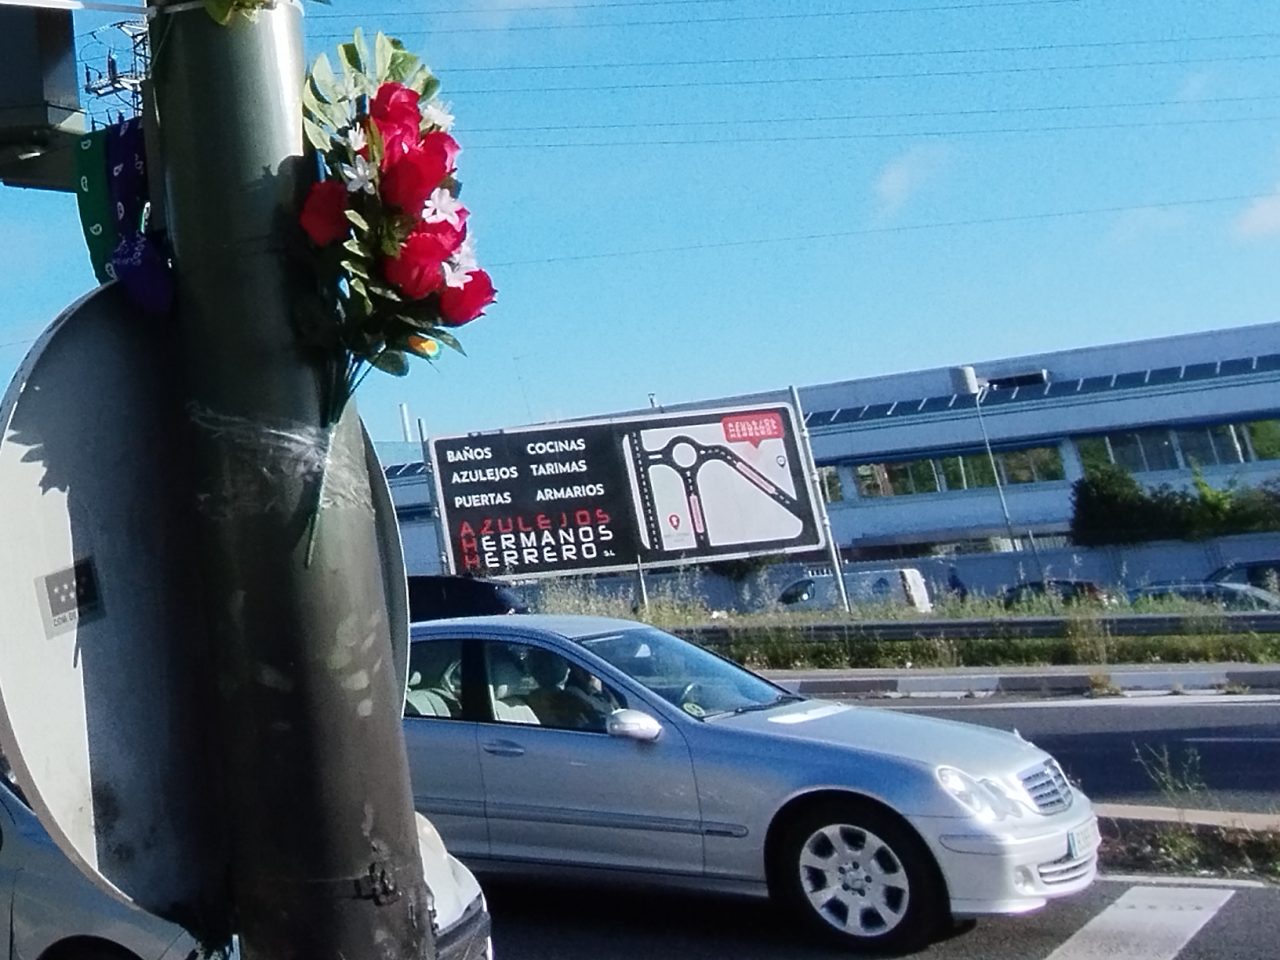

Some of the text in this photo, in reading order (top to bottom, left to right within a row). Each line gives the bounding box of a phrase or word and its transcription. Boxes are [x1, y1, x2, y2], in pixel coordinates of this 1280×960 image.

[446, 446, 493, 462] BAÑOS
[526, 438, 586, 455] COCINAS
[451, 466, 519, 484] AZULEJOS
[529, 460, 587, 476] TARIMAS
[454, 492, 512, 508] PUERTAS
[536, 484, 605, 501] ARMARIOS
[460, 509, 611, 536] AZULEJOS
[461, 525, 614, 553] HERMANOS
[463, 542, 597, 569] HERRERO
